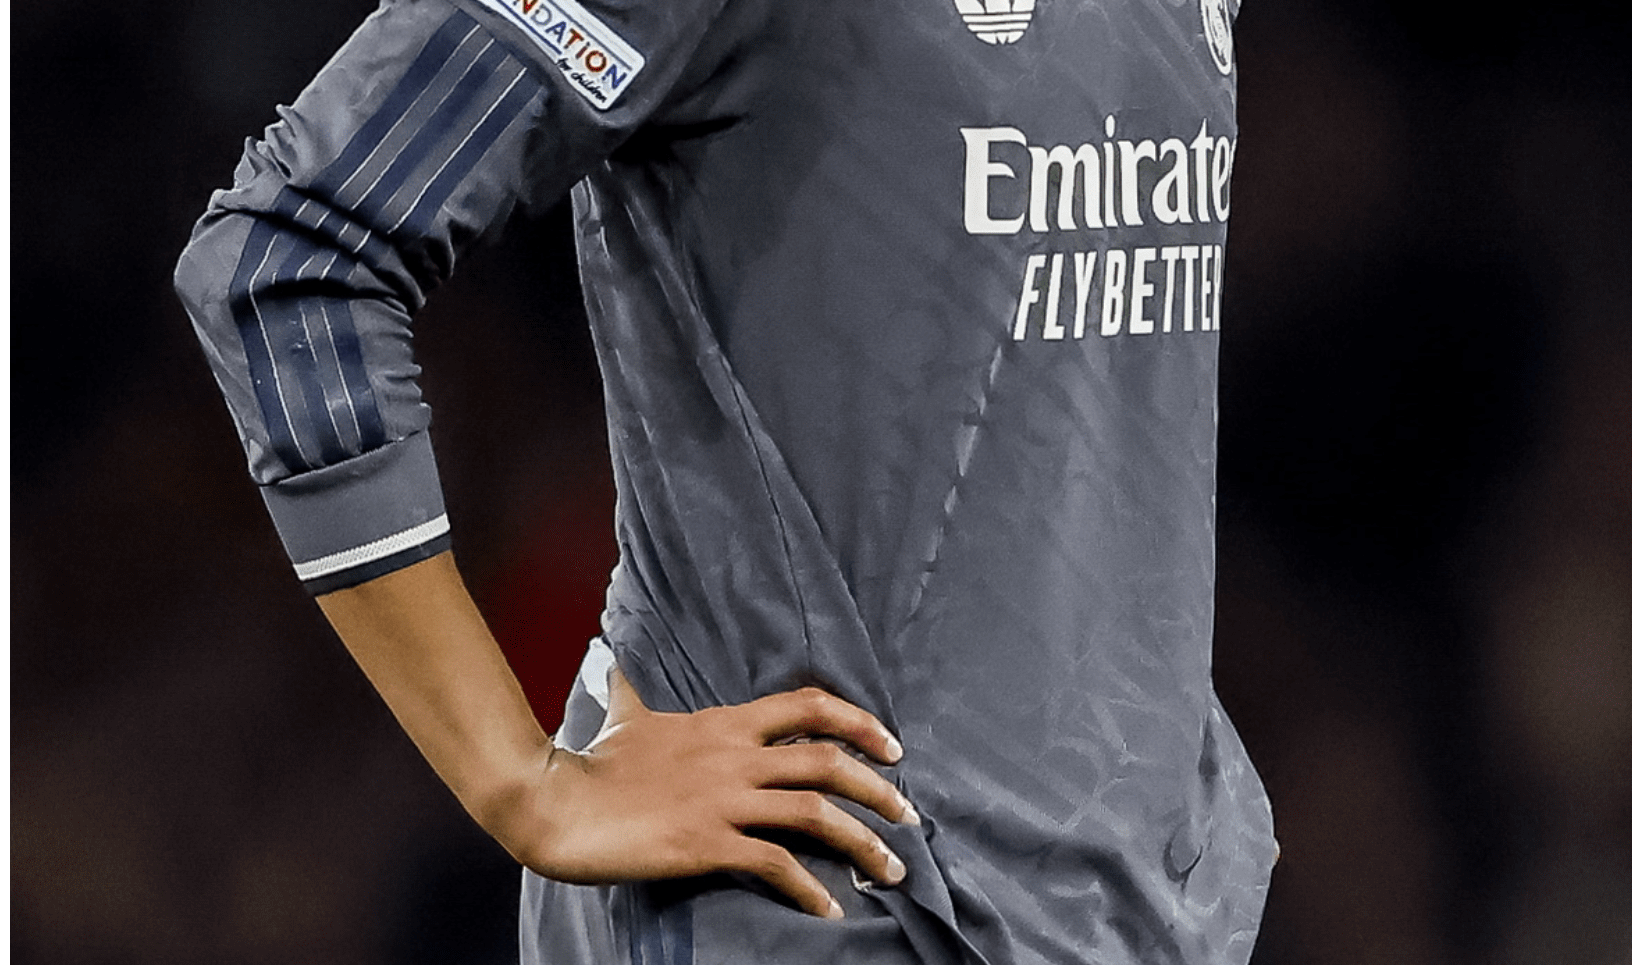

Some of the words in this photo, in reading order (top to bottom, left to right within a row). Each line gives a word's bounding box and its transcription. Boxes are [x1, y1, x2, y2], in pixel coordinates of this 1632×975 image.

[556, 56, 572, 74] for
[570, 70, 607, 103] children
[959, 114, 1236, 235] Emirate
